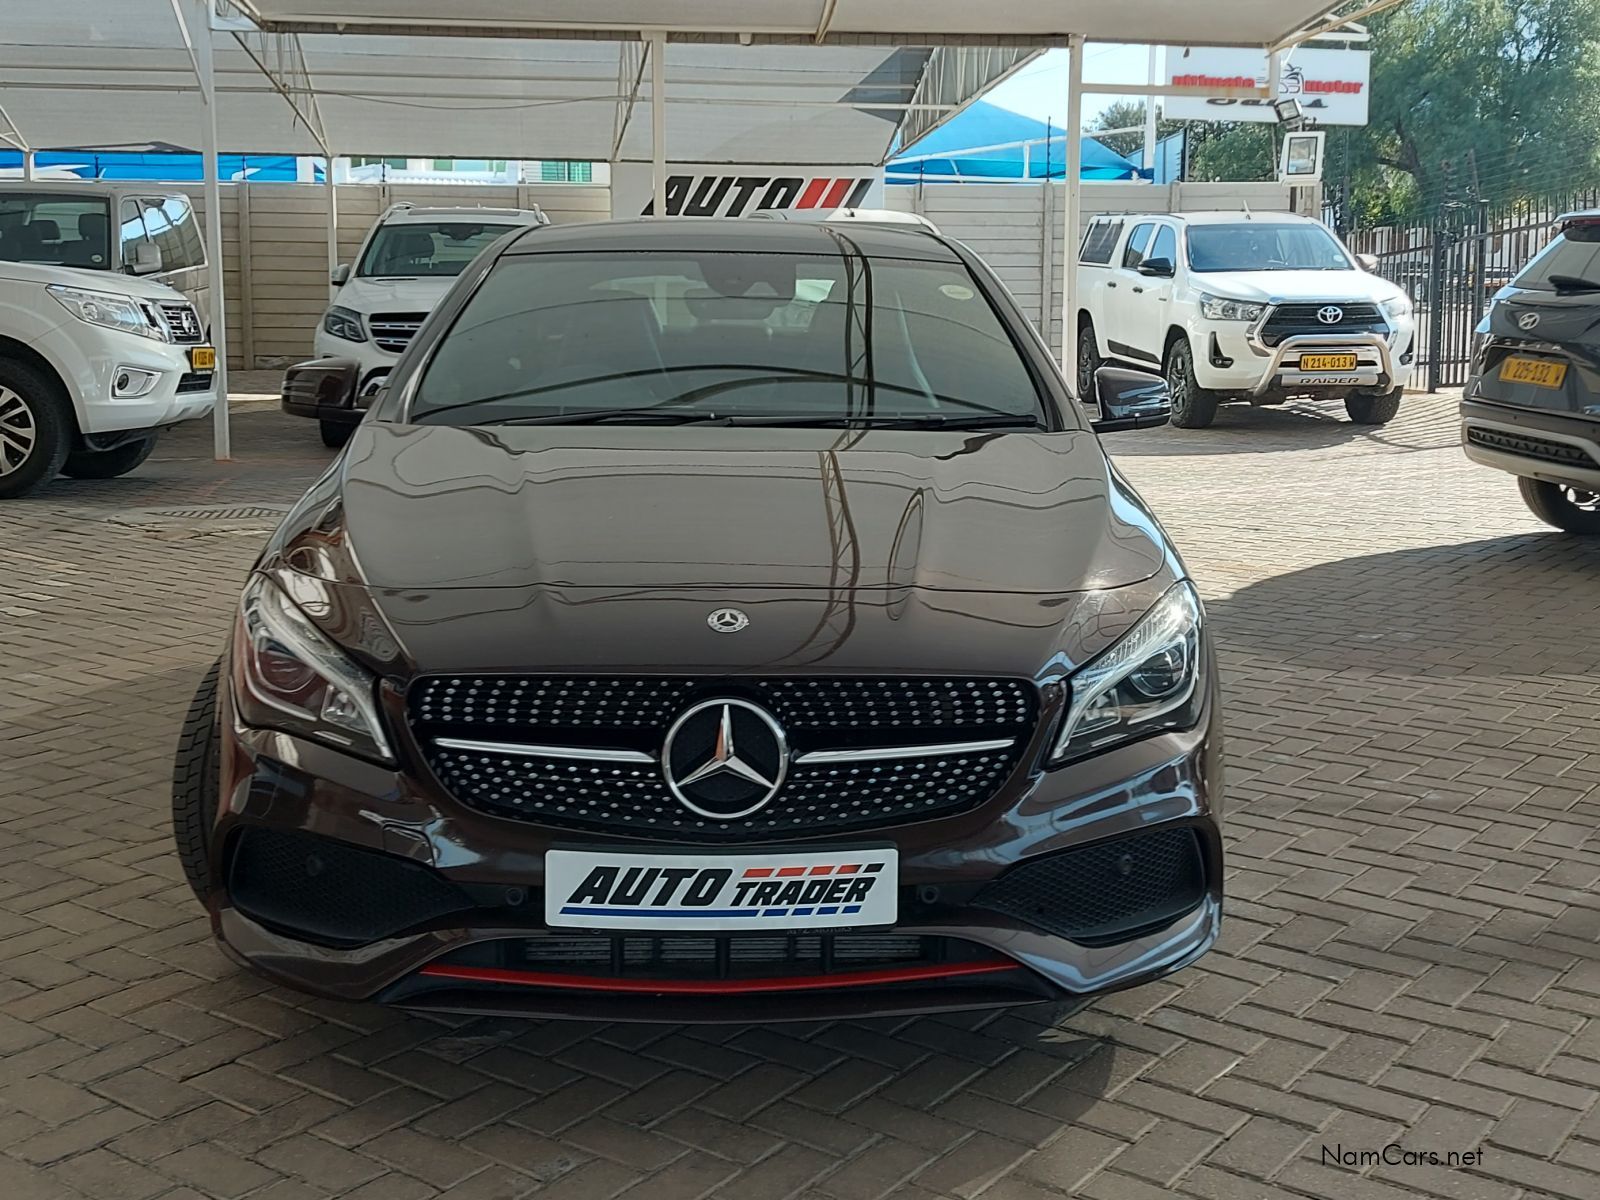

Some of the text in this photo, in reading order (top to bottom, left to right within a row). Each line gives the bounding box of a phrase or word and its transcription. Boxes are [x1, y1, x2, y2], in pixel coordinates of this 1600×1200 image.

[1304, 79, 1363, 94] motor
[640, 175, 804, 218] AUTO
[1303, 358, 1309, 369] N
[1311, 357, 1347, 369] 214-013
[566, 866, 877, 907] AUTO TRADER
